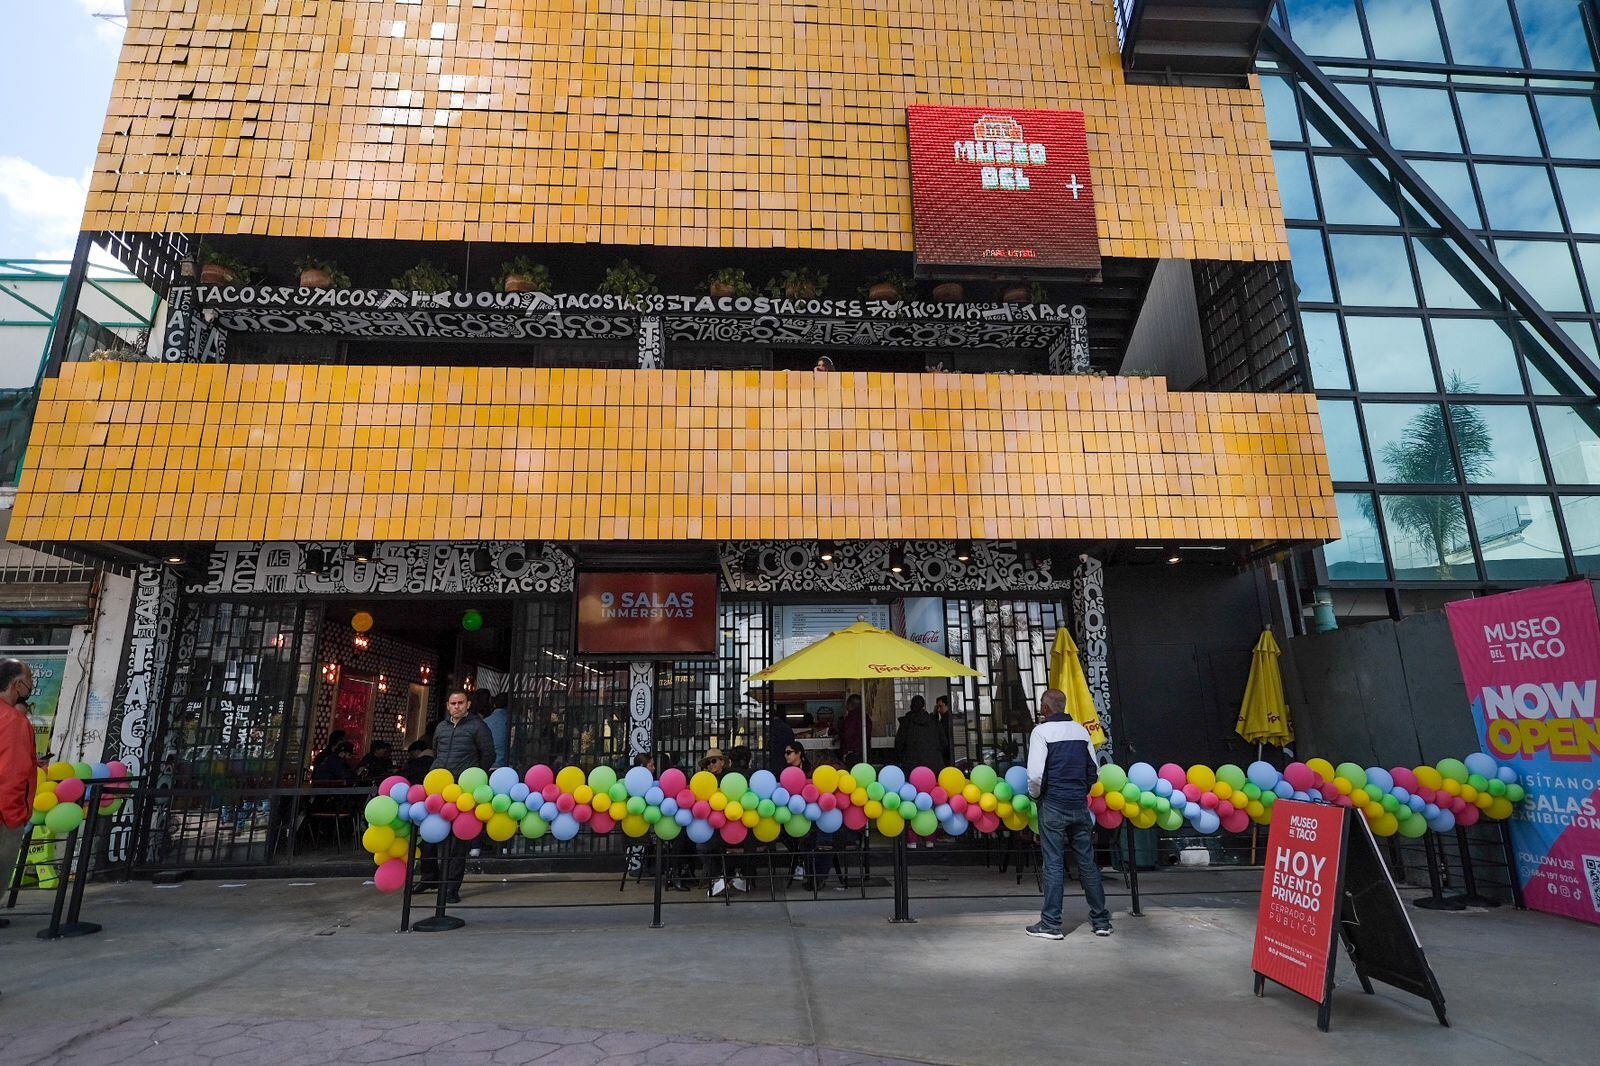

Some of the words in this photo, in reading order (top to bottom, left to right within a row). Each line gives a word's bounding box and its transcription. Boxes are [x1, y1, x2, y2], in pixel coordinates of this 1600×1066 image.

[954, 141, 1047, 165] MUSEO
[981, 167, 1031, 190] DEL
[196, 286, 273, 304] TACOS
[553, 293, 615, 309] TACOS
[680, 296, 771, 313] TACOS
[770, 299, 833, 315] TACOS
[904, 541, 950, 551] ACOS
[496, 578, 561, 593] TACOS
[601, 592, 614, 608] 9
[621, 592, 694, 608] SALAS
[601, 608, 693, 618] INMERSIVAS
[1484, 616, 1561, 642] MUSEO
[1490, 649, 1504, 659] DEL
[1506, 638, 1565, 661] TACO
[868, 663, 900, 673] Topo
[900, 663, 933, 673] Chico
[123, 704, 147, 714] TACO
[1481, 680, 1597, 719] NOW
[1489, 718, 1600, 756] OPEN
[1524, 794, 1596, 816] SALAS
[1290, 815, 1318, 830] MUSEO
[1296, 828, 1316, 841] TACO
[1275, 846, 1327, 881] HOY
[1519, 852, 1558, 867] FOLLOW
[1274, 871, 1322, 896] EVENTO
[1271, 885, 1320, 912] PRIVADO
[1271, 902, 1305, 921] CERRADO
[1307, 915, 1317, 926] AL
